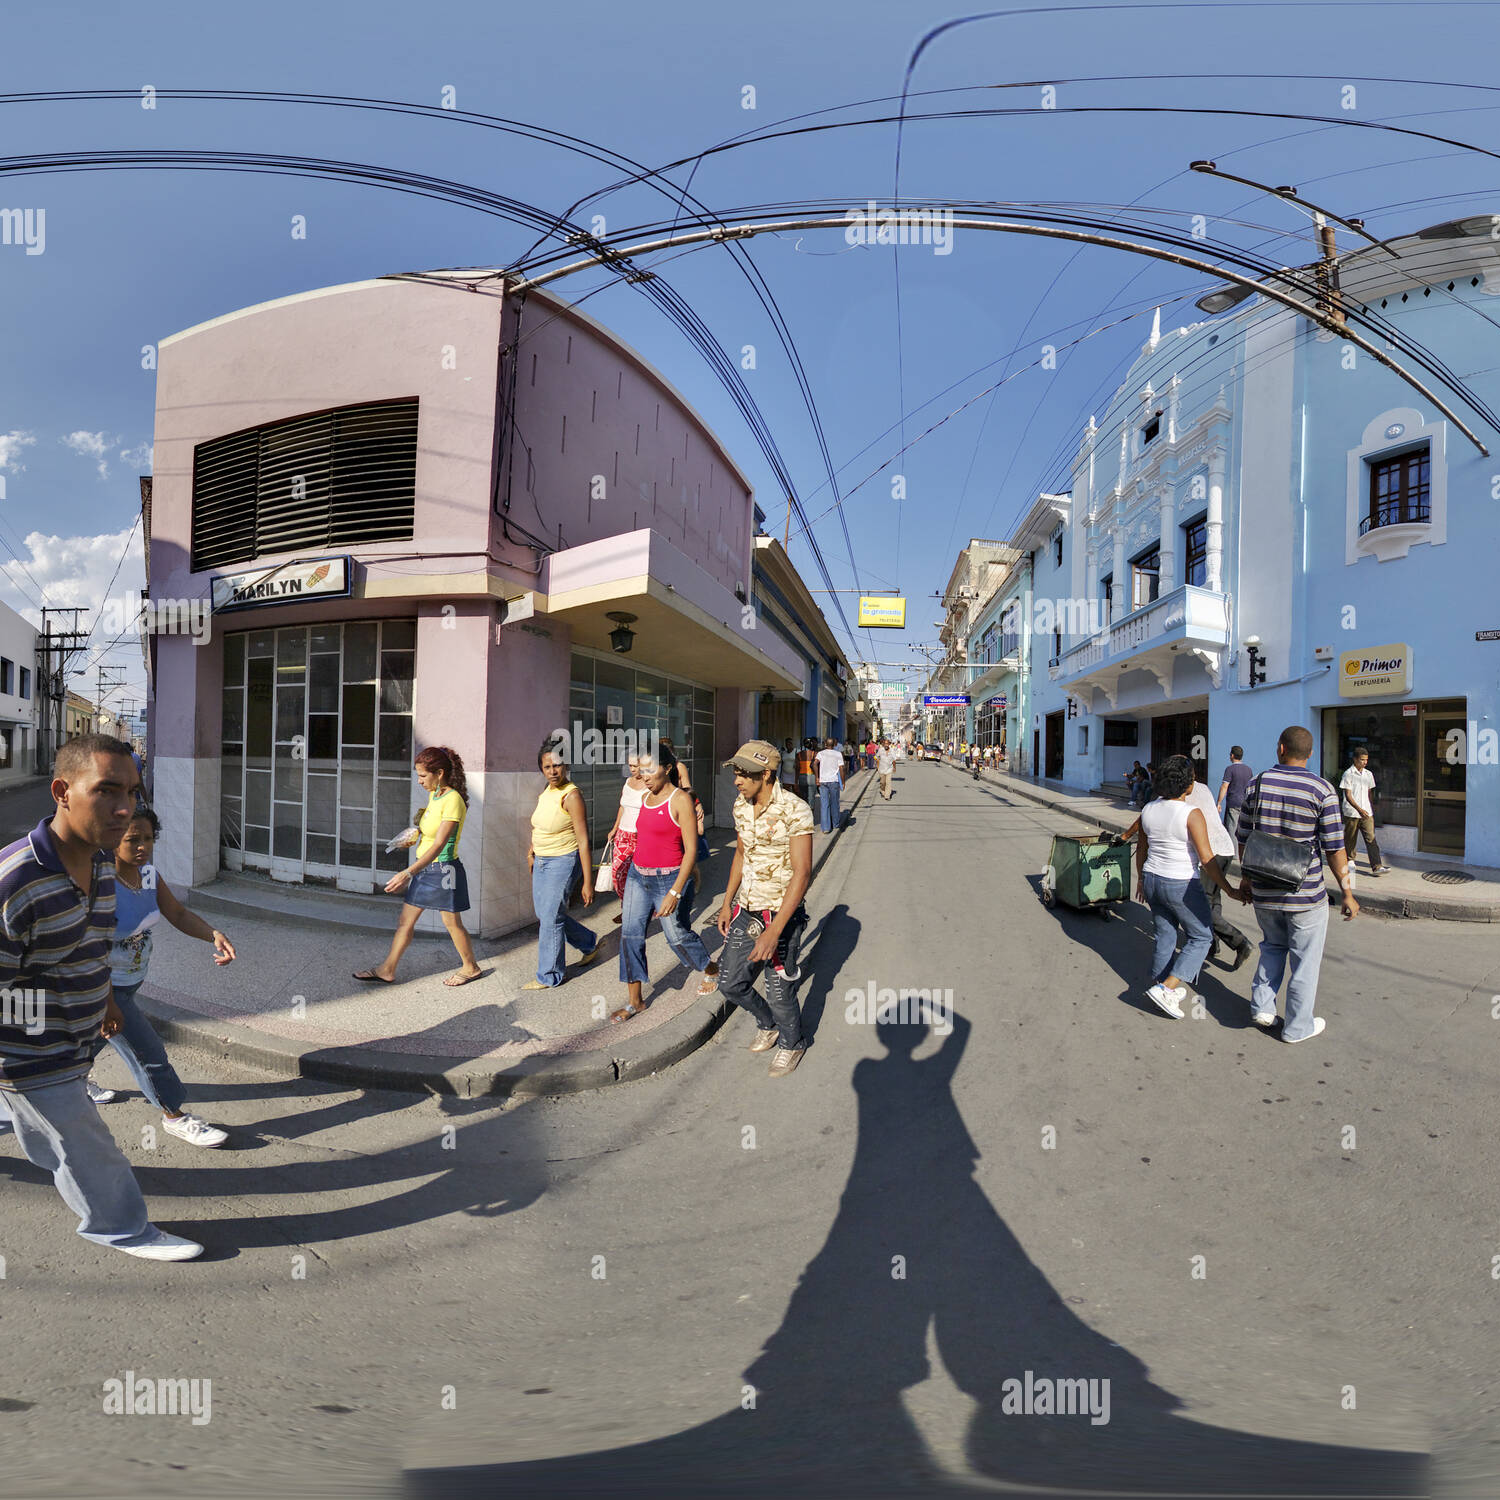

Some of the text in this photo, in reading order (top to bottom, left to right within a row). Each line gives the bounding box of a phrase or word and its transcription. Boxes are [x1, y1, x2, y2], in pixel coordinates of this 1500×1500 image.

[233, 579, 302, 602] MARILYN
[1361, 658, 1402, 672] Primor
[1101, 869, 1111, 882] 4
